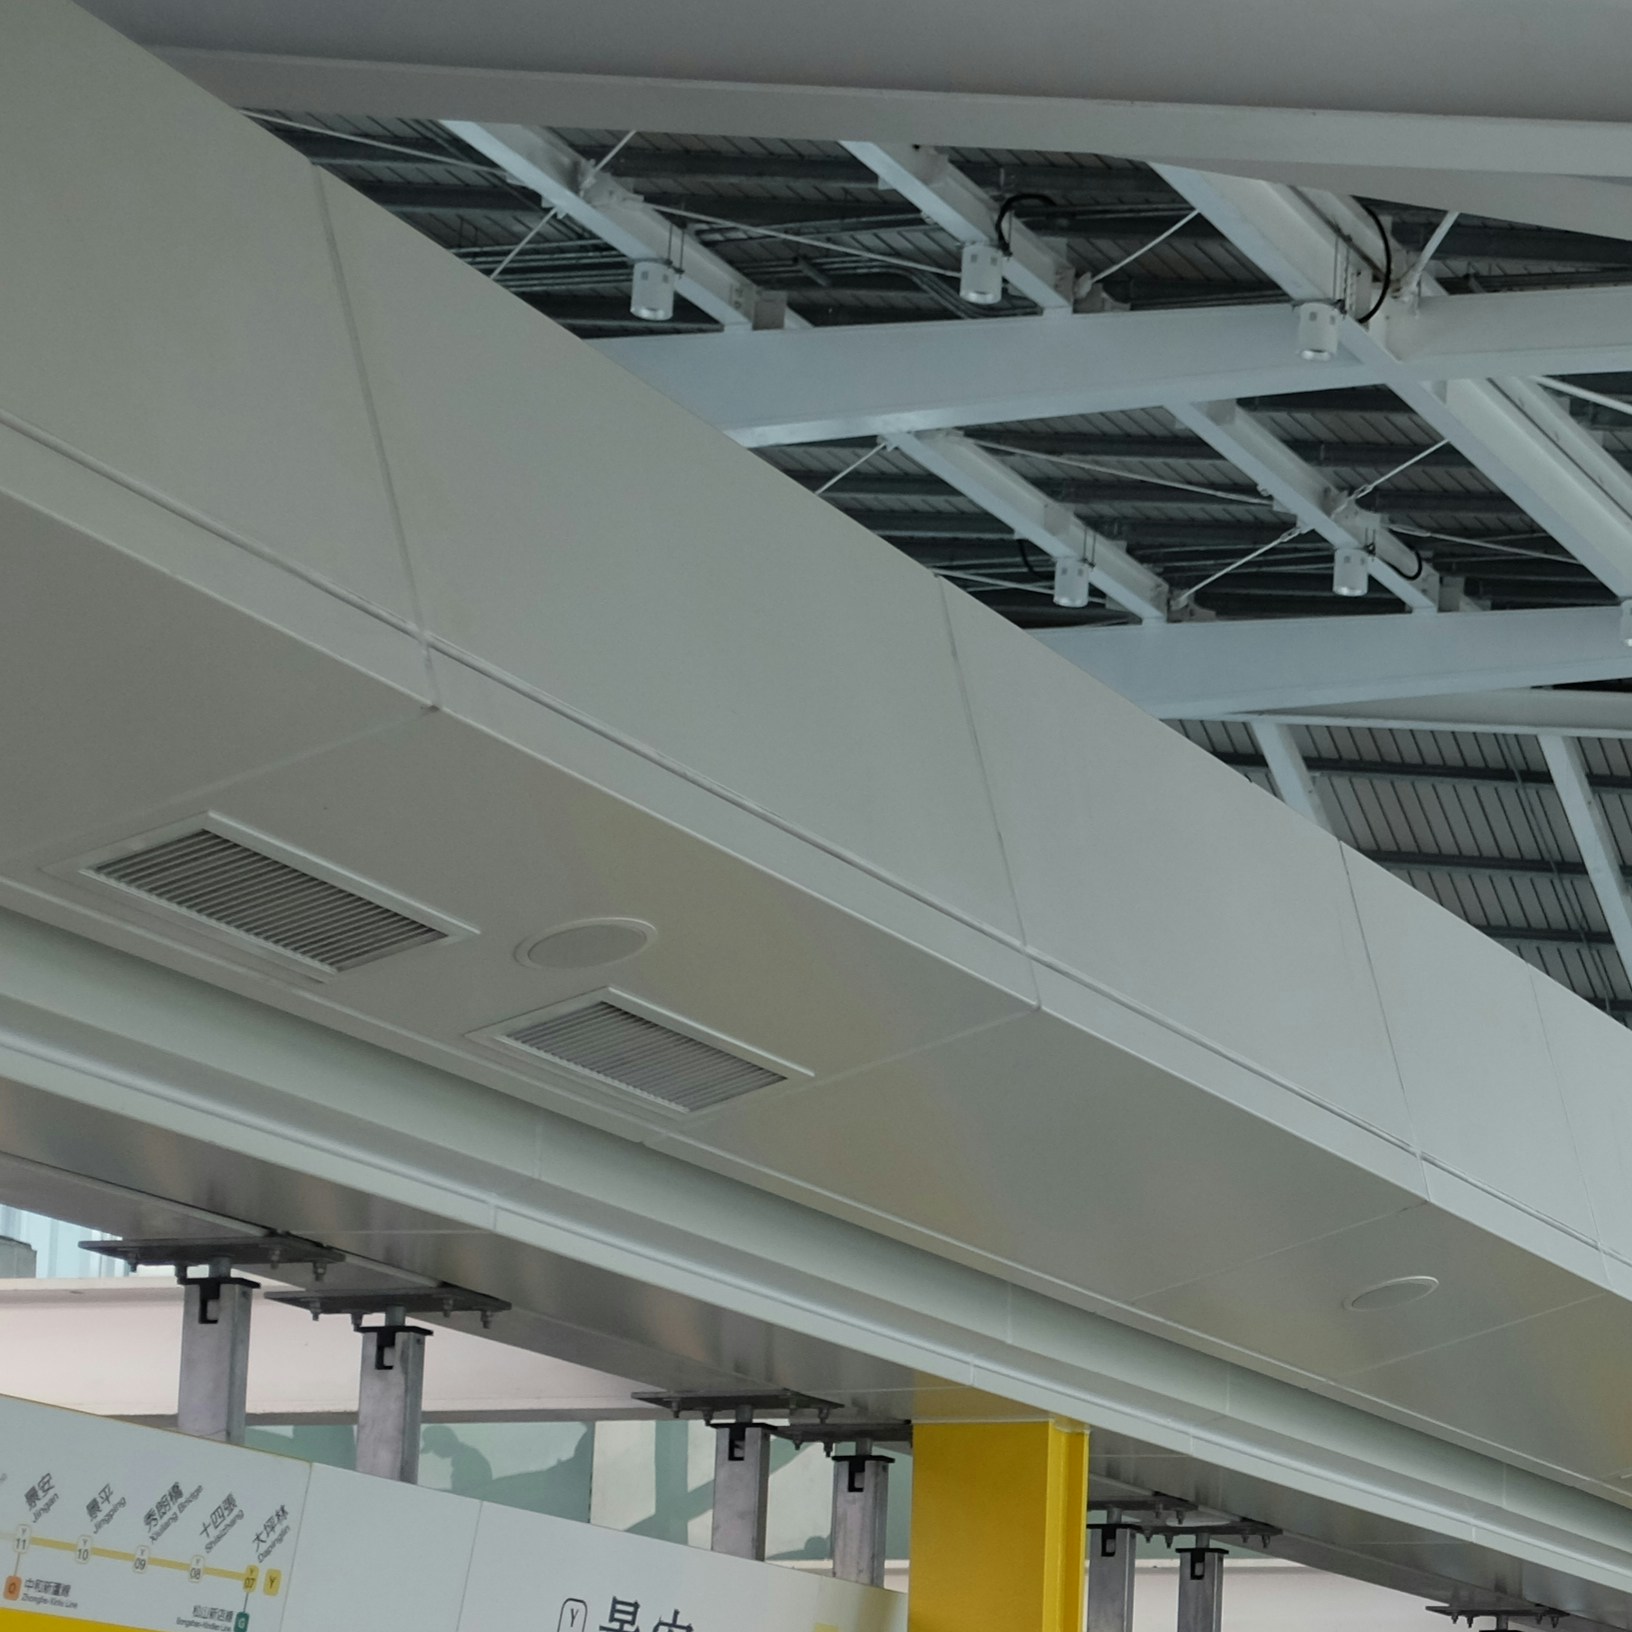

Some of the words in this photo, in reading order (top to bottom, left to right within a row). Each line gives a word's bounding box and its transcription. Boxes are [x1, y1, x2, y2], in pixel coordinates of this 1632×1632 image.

[252, 1504, 288, 1552] 大坪林
[269, 1576, 276, 1589] Y
[570, 1608, 579, 1628] Y
